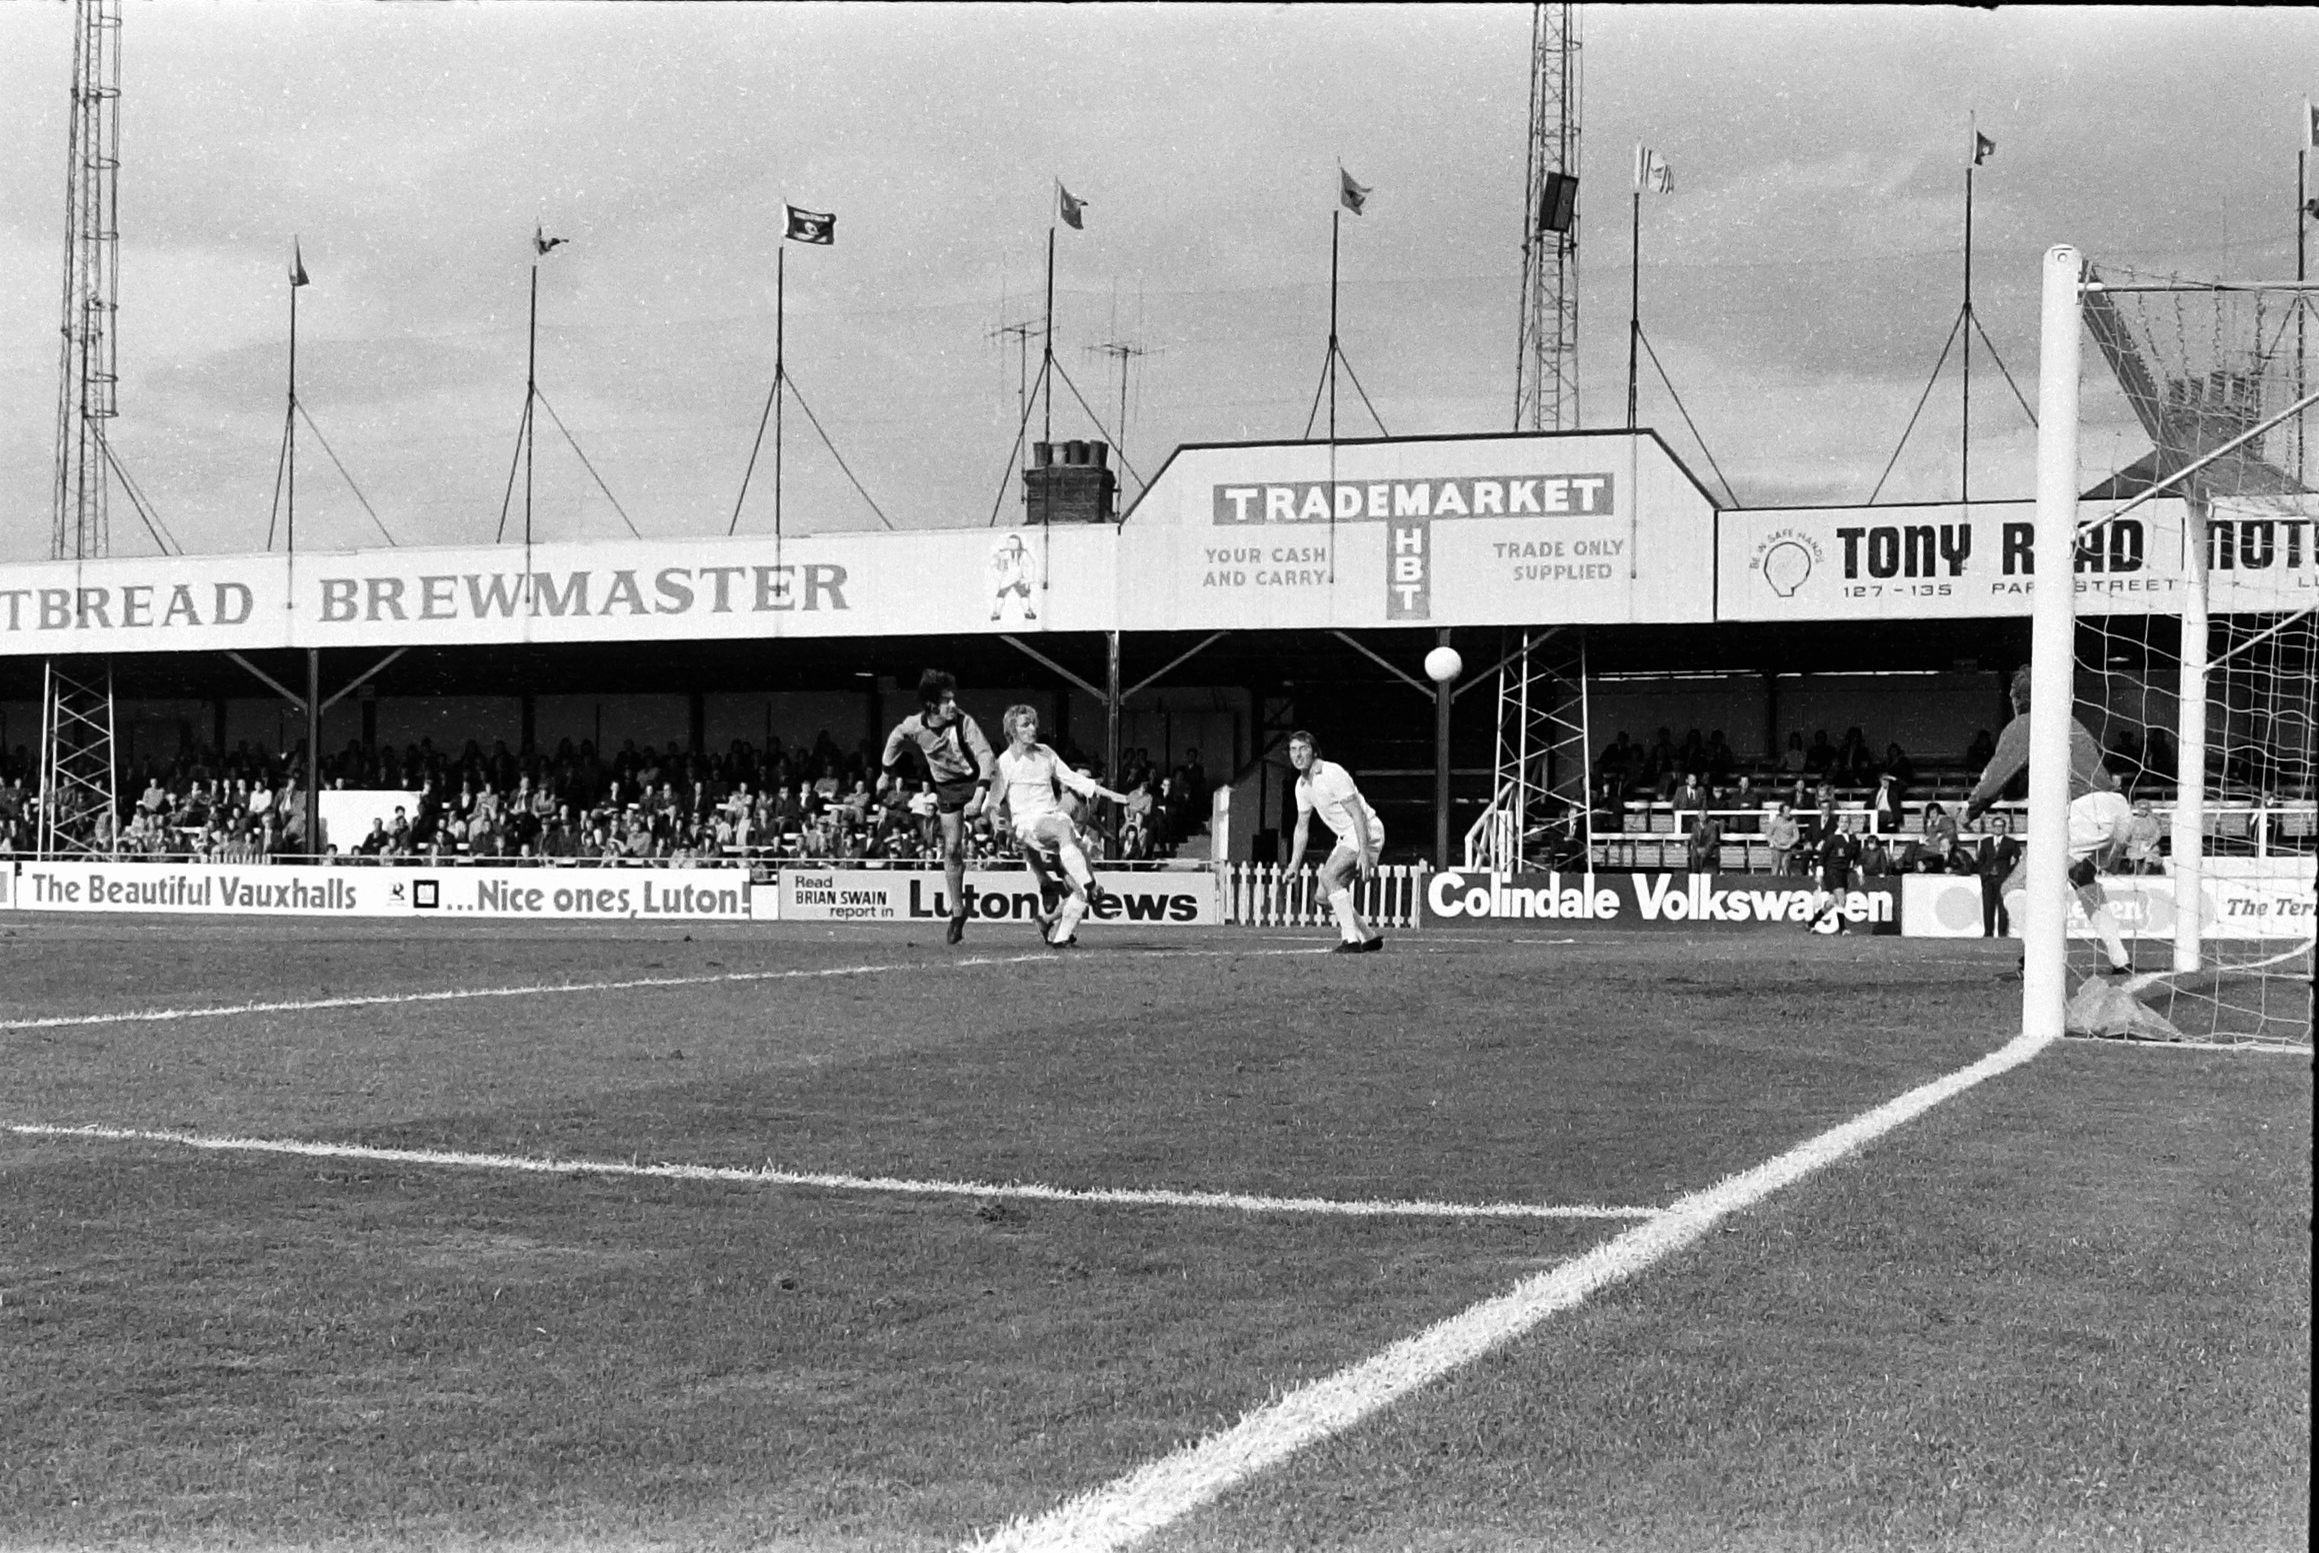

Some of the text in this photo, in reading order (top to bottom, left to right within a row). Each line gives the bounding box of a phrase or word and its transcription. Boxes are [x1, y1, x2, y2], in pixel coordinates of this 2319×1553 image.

[1225, 479, 1605, 520] TRADEMARKET
[1206, 547, 1326, 564] YOUR CASH
[1493, 539, 1624, 559] TRADE ONLY
[2002, 519, 2143, 575] RAD
[1203, 570, 1326, 587] AND CARRY
[1514, 563, 1612, 581] SUPPLIED
[318, 563, 850, 623] BREWMASTER
[2075, 579, 2178, 593] STREET
[32, 873, 357, 909] The Beautiful Vauxhalls
[795, 875, 833, 888] Read
[553, 888, 638, 919] ones,
[644, 880, 750, 913] Luton!
[796, 891, 887, 905] BRIAN SWAIN
[1428, 872, 1620, 919] Colindale
[829, 906, 894, 920] report in
[2228, 898, 2268, 917] The
